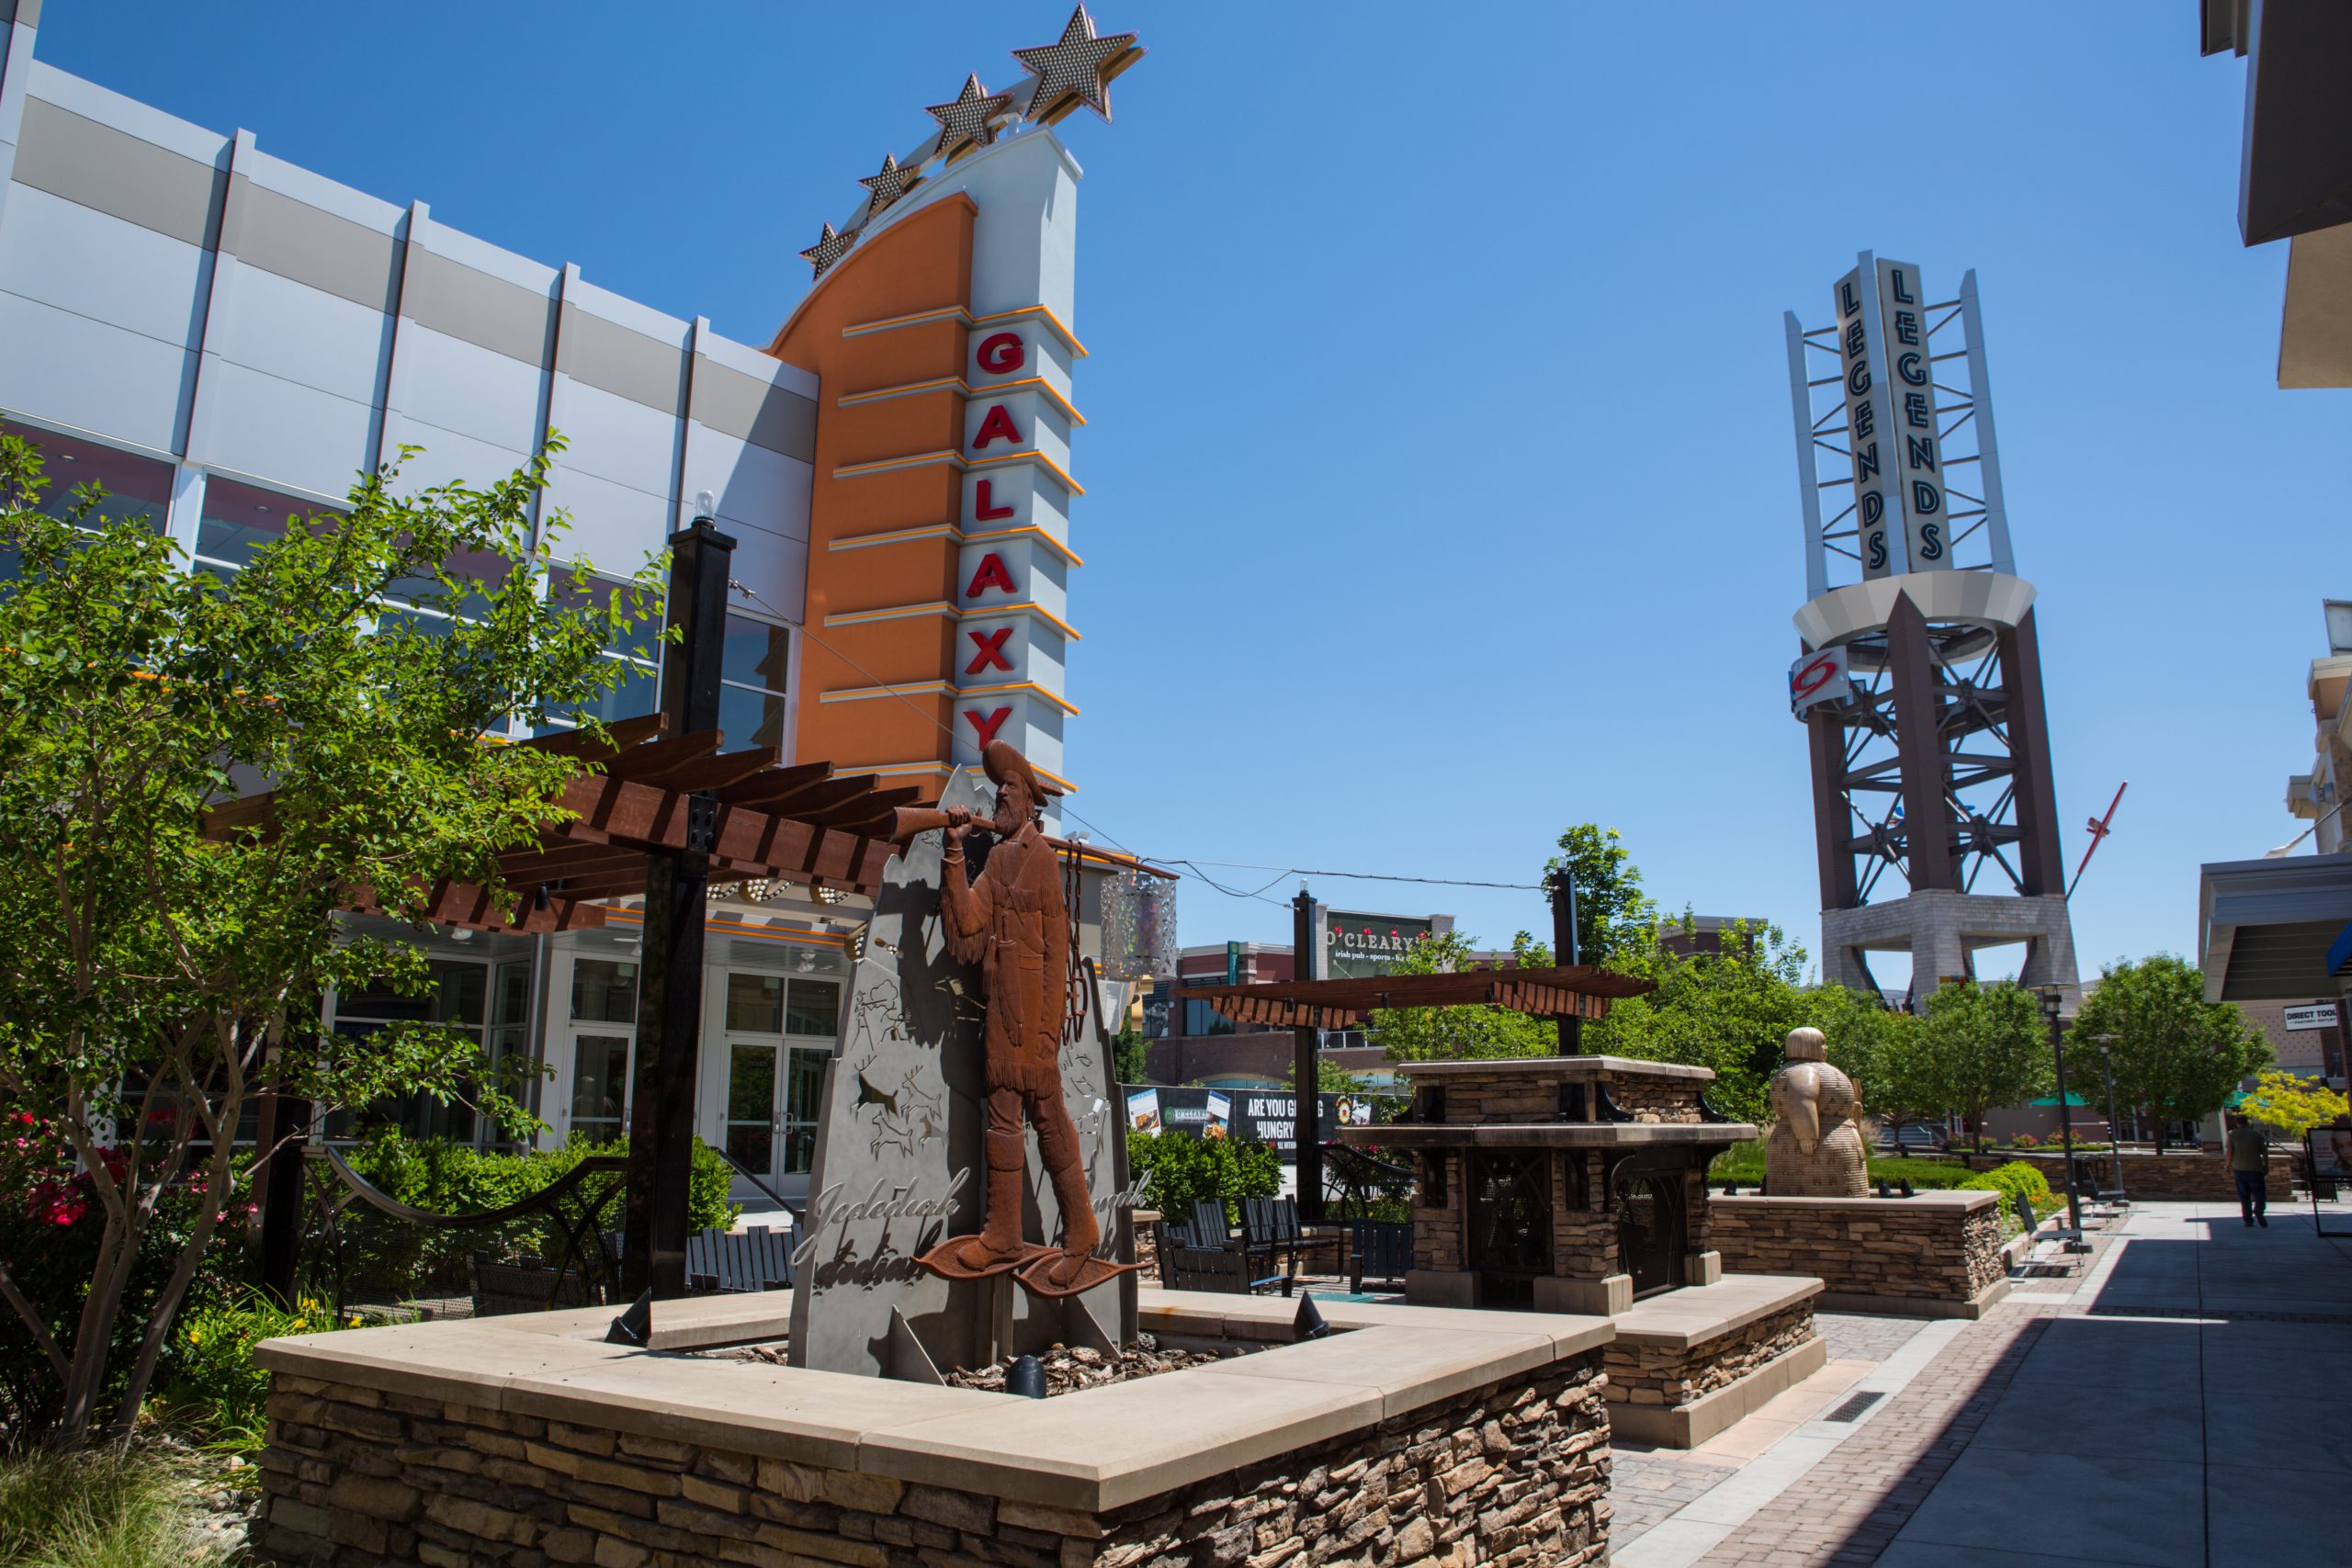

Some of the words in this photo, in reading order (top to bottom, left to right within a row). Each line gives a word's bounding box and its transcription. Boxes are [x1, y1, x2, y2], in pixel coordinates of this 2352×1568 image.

[1841, 282, 1886, 570] LEGENDS
[1891, 268, 1942, 560] LEGENDS
[963, 332, 1023, 751] GALAXY
[1335, 950, 1351, 958] irish
[1351, 952, 1365, 960] pub
[1370, 953, 1391, 962] sports
[2287, 1011, 2314, 1020] DIRECT
[1248, 1099, 1266, 1116] ARE
[1267, 1099, 1285, 1117] YOU
[1257, 1121, 1295, 1139] HUNGRY
[791, 1167, 970, 1267] Jedediah
[1091, 1168, 1152, 1213] mith
